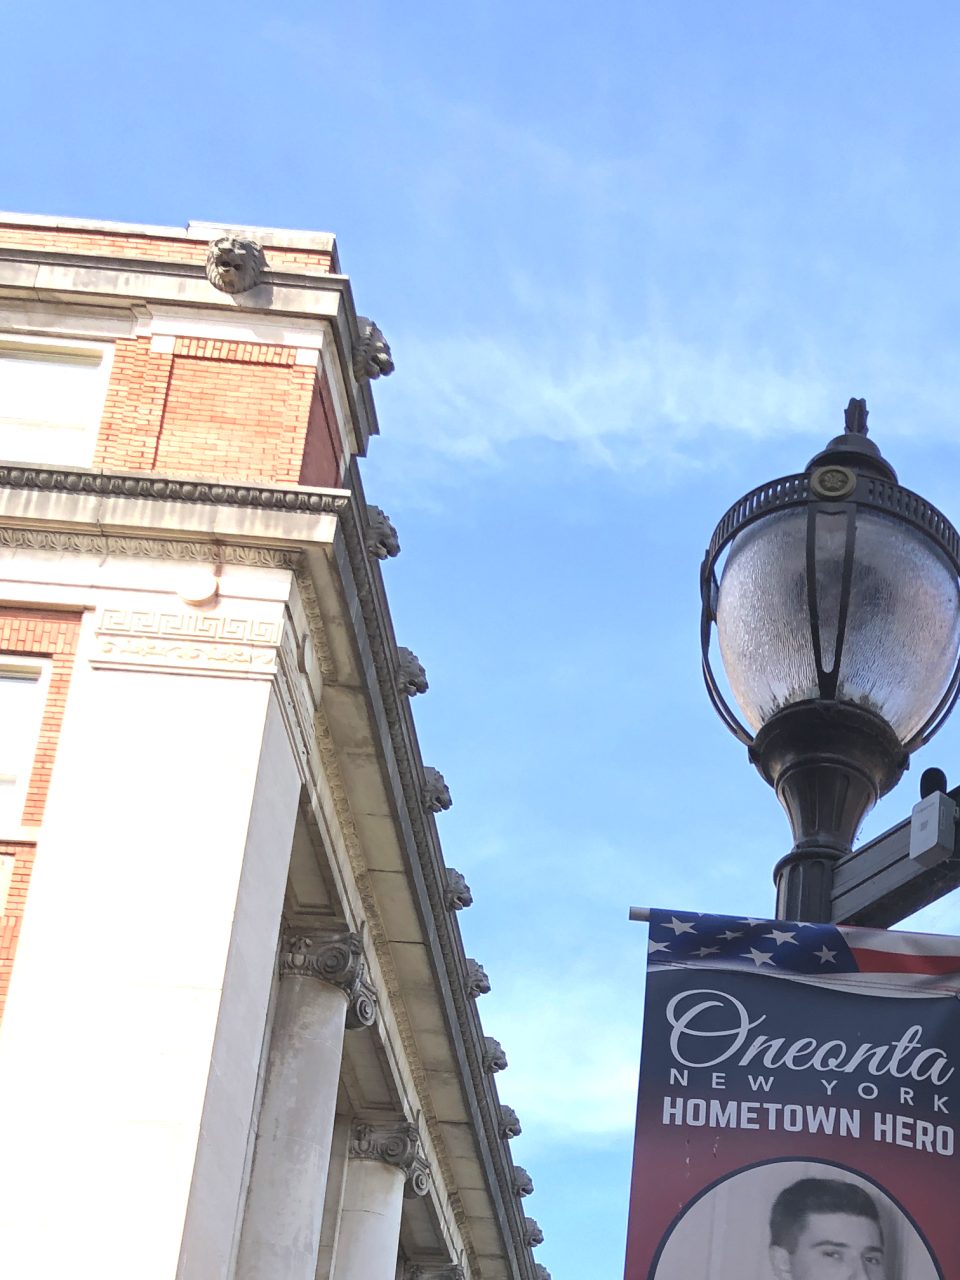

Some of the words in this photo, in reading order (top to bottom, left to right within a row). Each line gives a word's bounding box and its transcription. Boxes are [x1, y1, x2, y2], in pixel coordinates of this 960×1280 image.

[666, 989, 955, 1085] Oneonta
[669, 1068, 775, 1092] NEW
[821, 1079, 949, 1114] YORK
[662, 1096, 861, 1138] HOMETOWN
[874, 1112, 955, 1156] HERO
